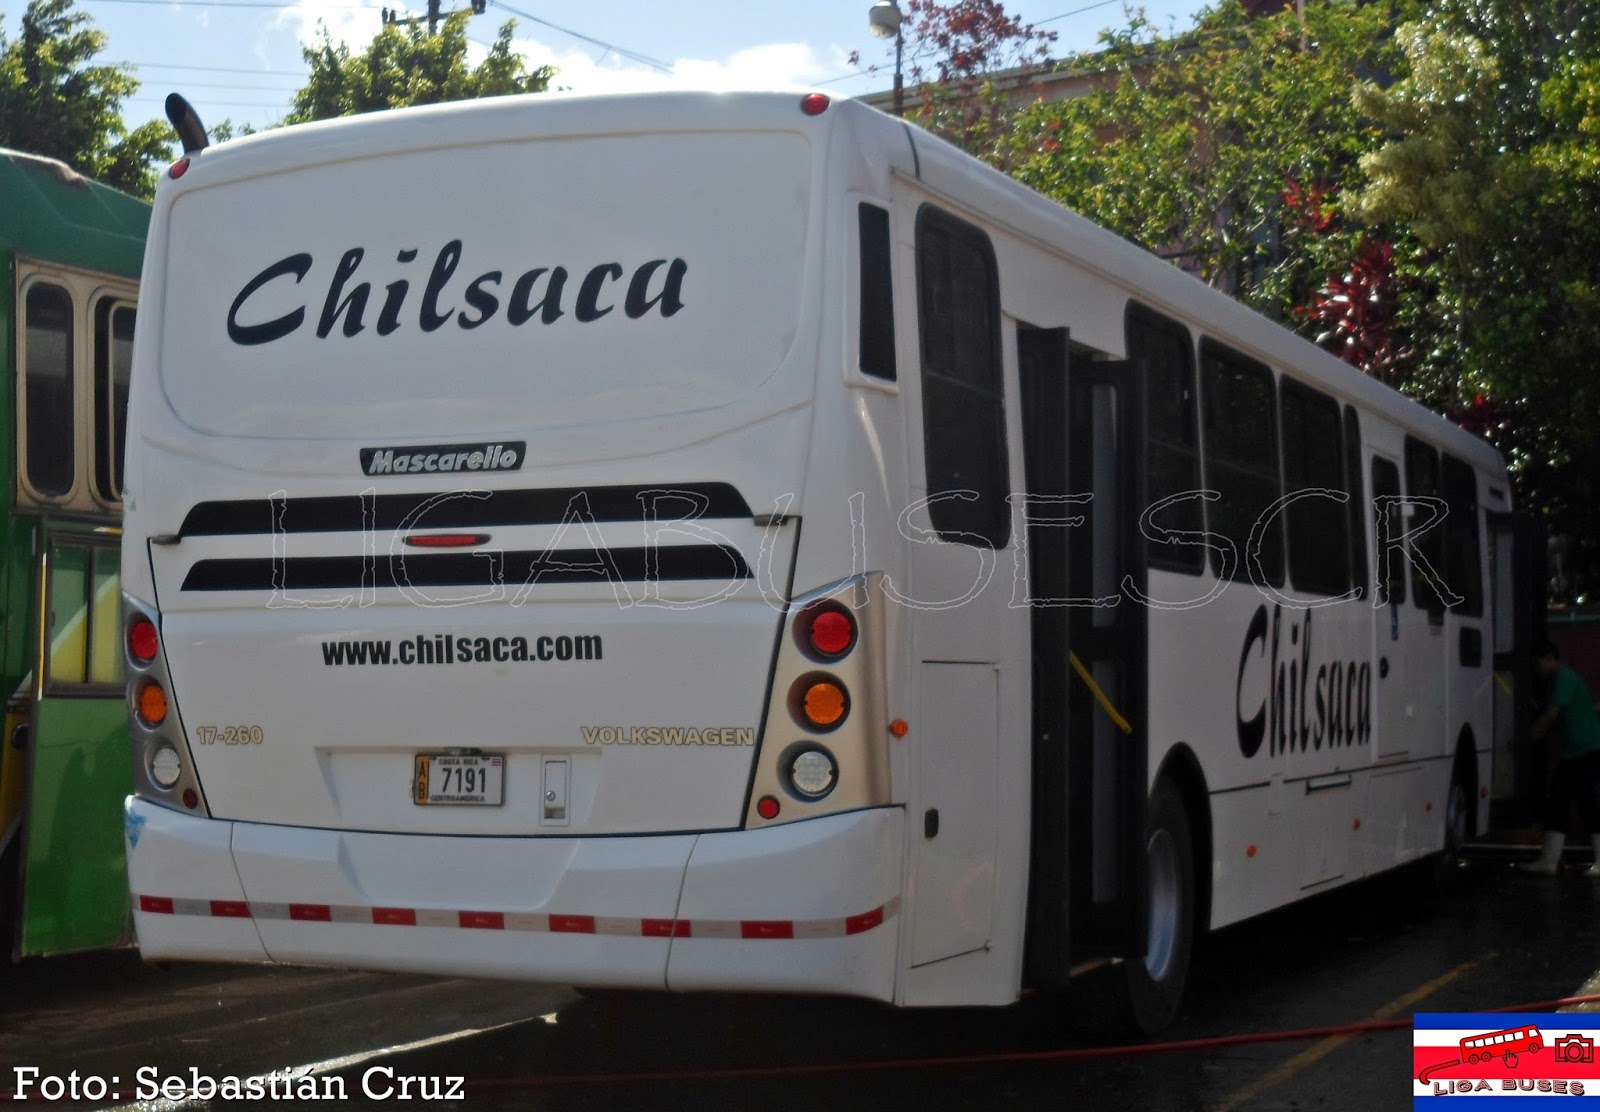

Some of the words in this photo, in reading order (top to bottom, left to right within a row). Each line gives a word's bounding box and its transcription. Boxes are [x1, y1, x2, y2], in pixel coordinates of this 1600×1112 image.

[226, 239, 688, 346] Chilsaca
[367, 445, 518, 473] Mascarello
[321, 633, 603, 666] www.chilsaca.com
[1236, 601, 1371, 758] Chilsaca
[196, 725, 264, 745] 17-260
[580, 726, 755, 747] VOLKSWAGEN
[438, 758, 461, 766] COSTA
[463, 758, 479, 766] RICA
[441, 767, 487, 793] 7191
